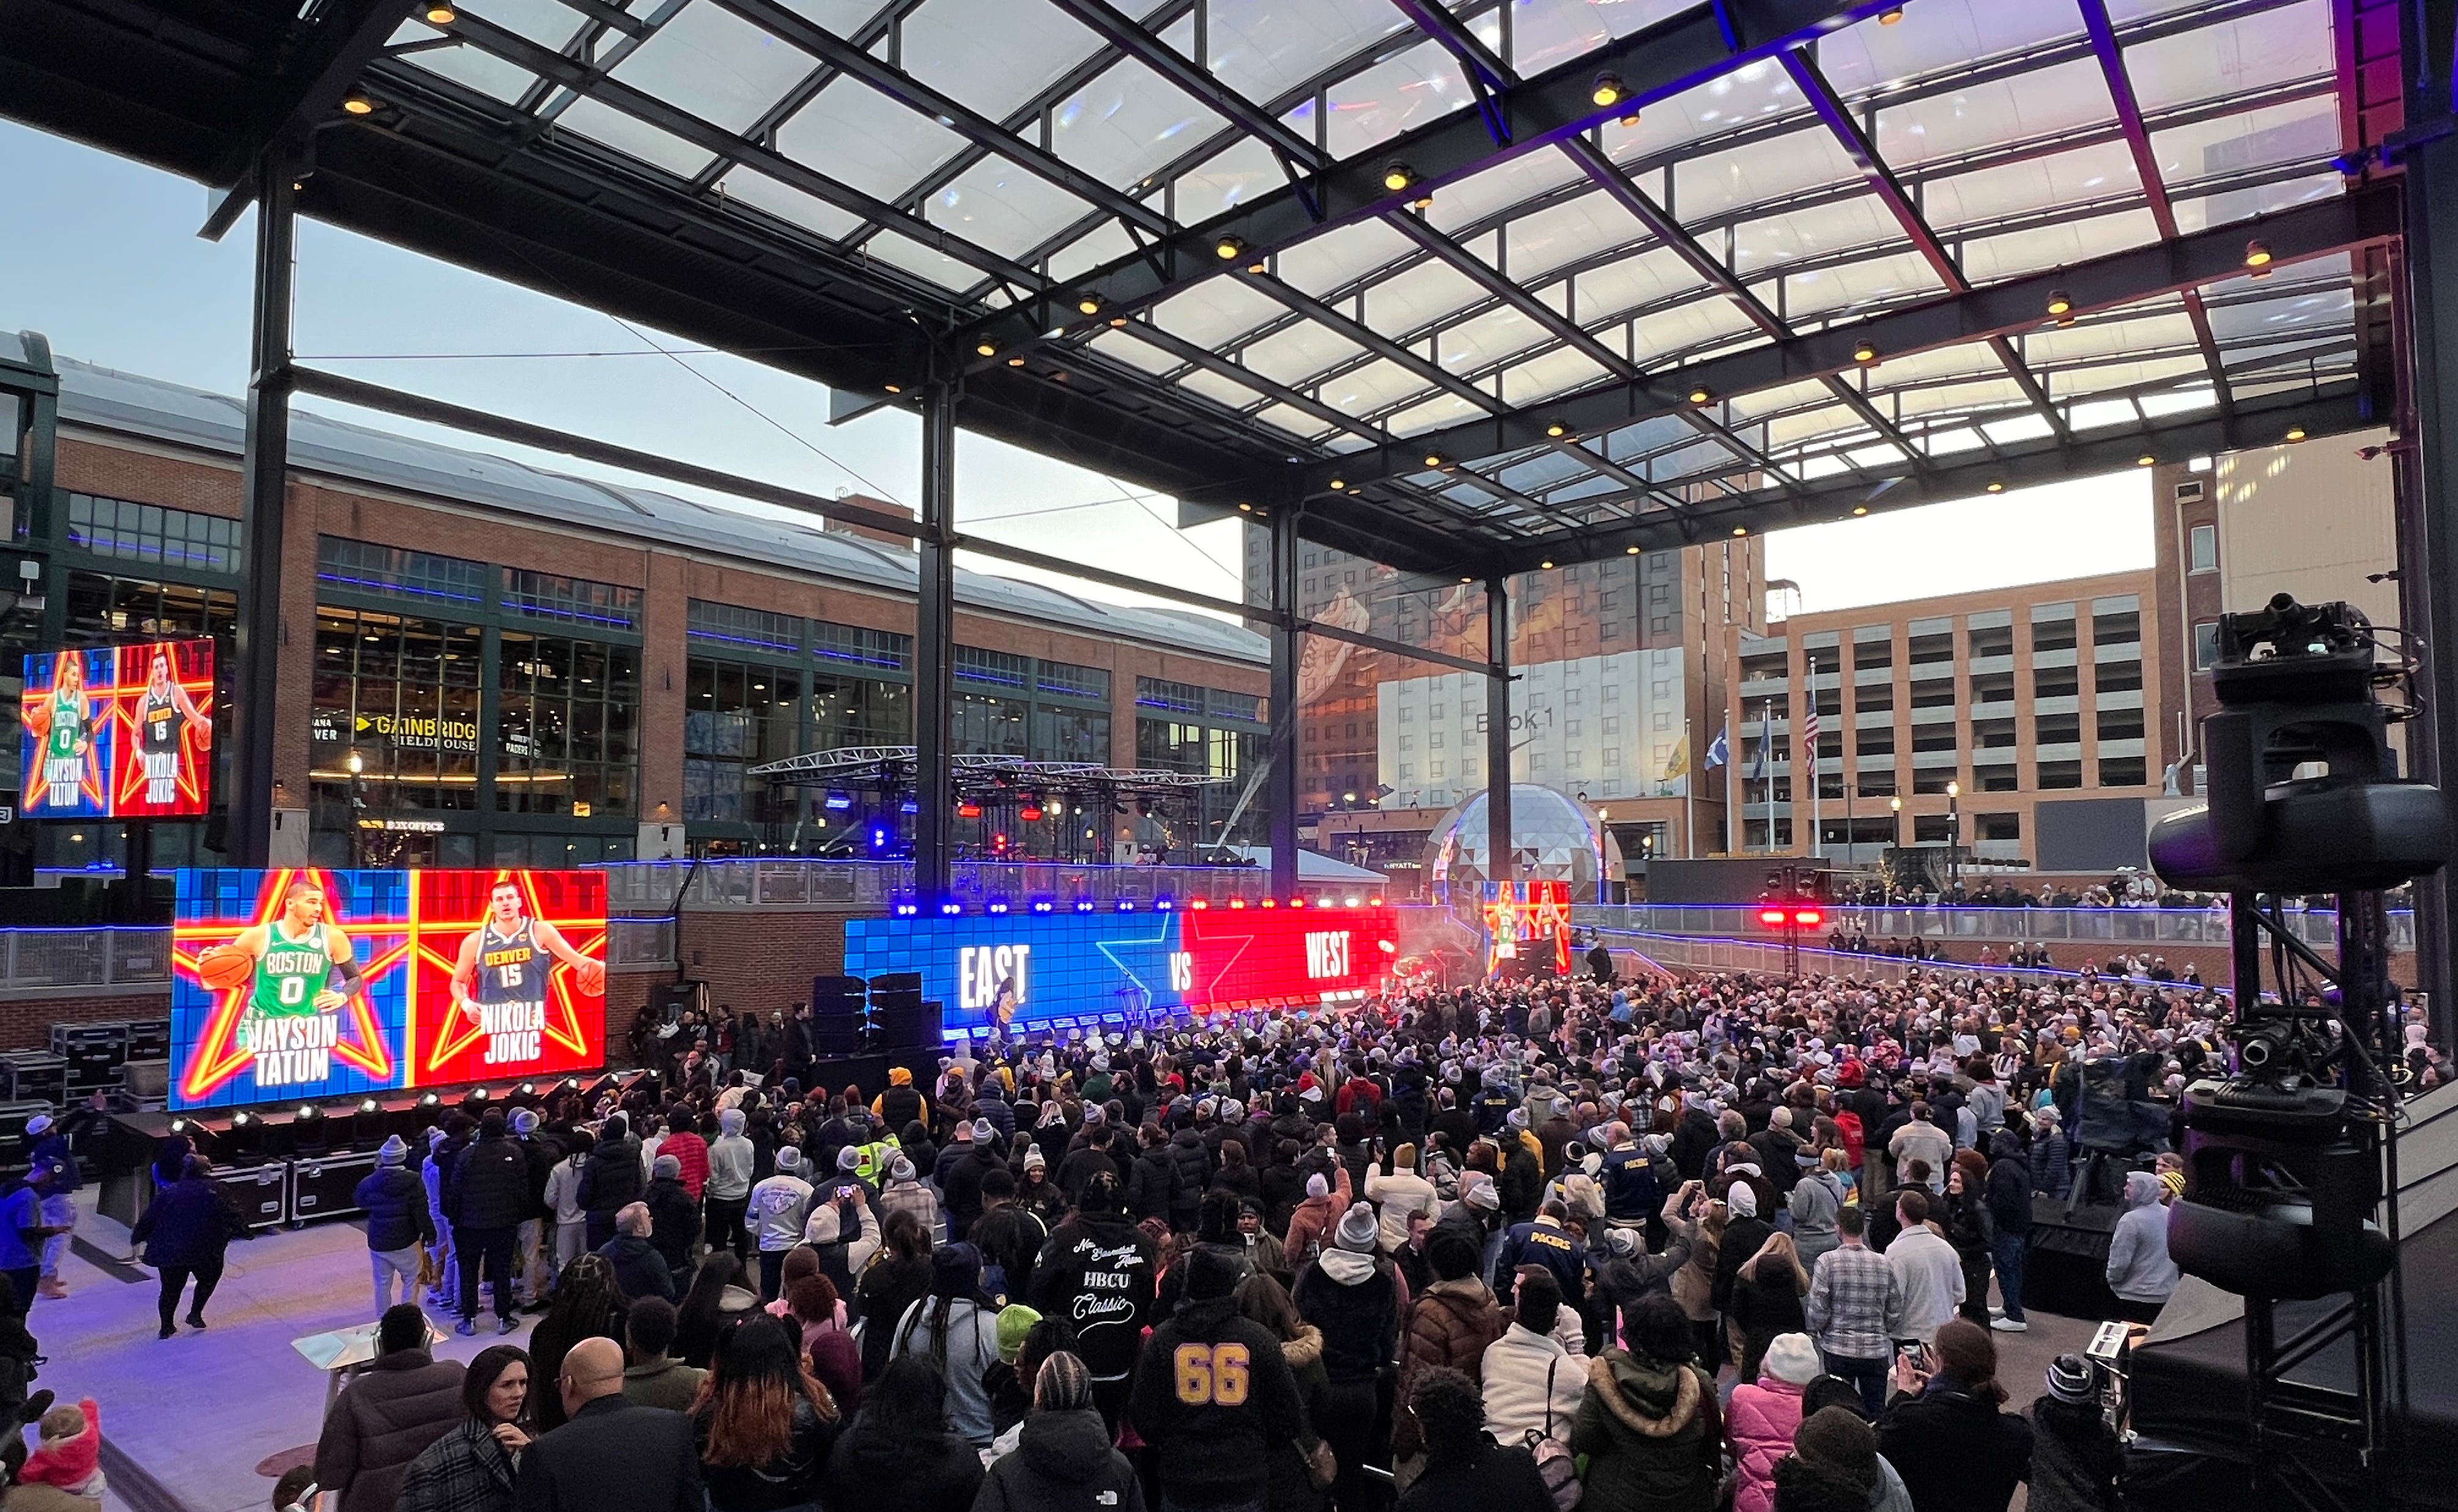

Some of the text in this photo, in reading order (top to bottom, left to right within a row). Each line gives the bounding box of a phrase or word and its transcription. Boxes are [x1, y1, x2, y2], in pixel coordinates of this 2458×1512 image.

[155, 721, 167, 741] 15
[1477, 707, 1552, 733] Bok 1
[59, 729, 71, 749] 0
[48, 758, 83, 782] JAYSON
[146, 753, 178, 778] NIKOLA
[50, 782, 79, 806] TATUM
[146, 778, 175, 803] JOKIC
[267, 951, 323, 974] BOSTON
[484, 948, 531, 966] DENVER
[1305, 931, 1349, 978] WEST
[499, 964, 523, 988] 15
[961, 945, 1029, 1008] EAST
[1170, 952, 1191, 990] VS
[279, 976, 304, 1004] 0
[481, 1001, 545, 1034] NIKOLA
[246, 1015, 338, 1053] JAYSON
[484, 1031, 541, 1064] JOKIC
[254, 1048, 329, 1086] TATUM
[1531, 1232, 1571, 1250] PACERS
[1084, 1271, 1131, 1289] HBCU
[1073, 1293, 1135, 1321] Classic
[1174, 1342, 1250, 1406] 66
